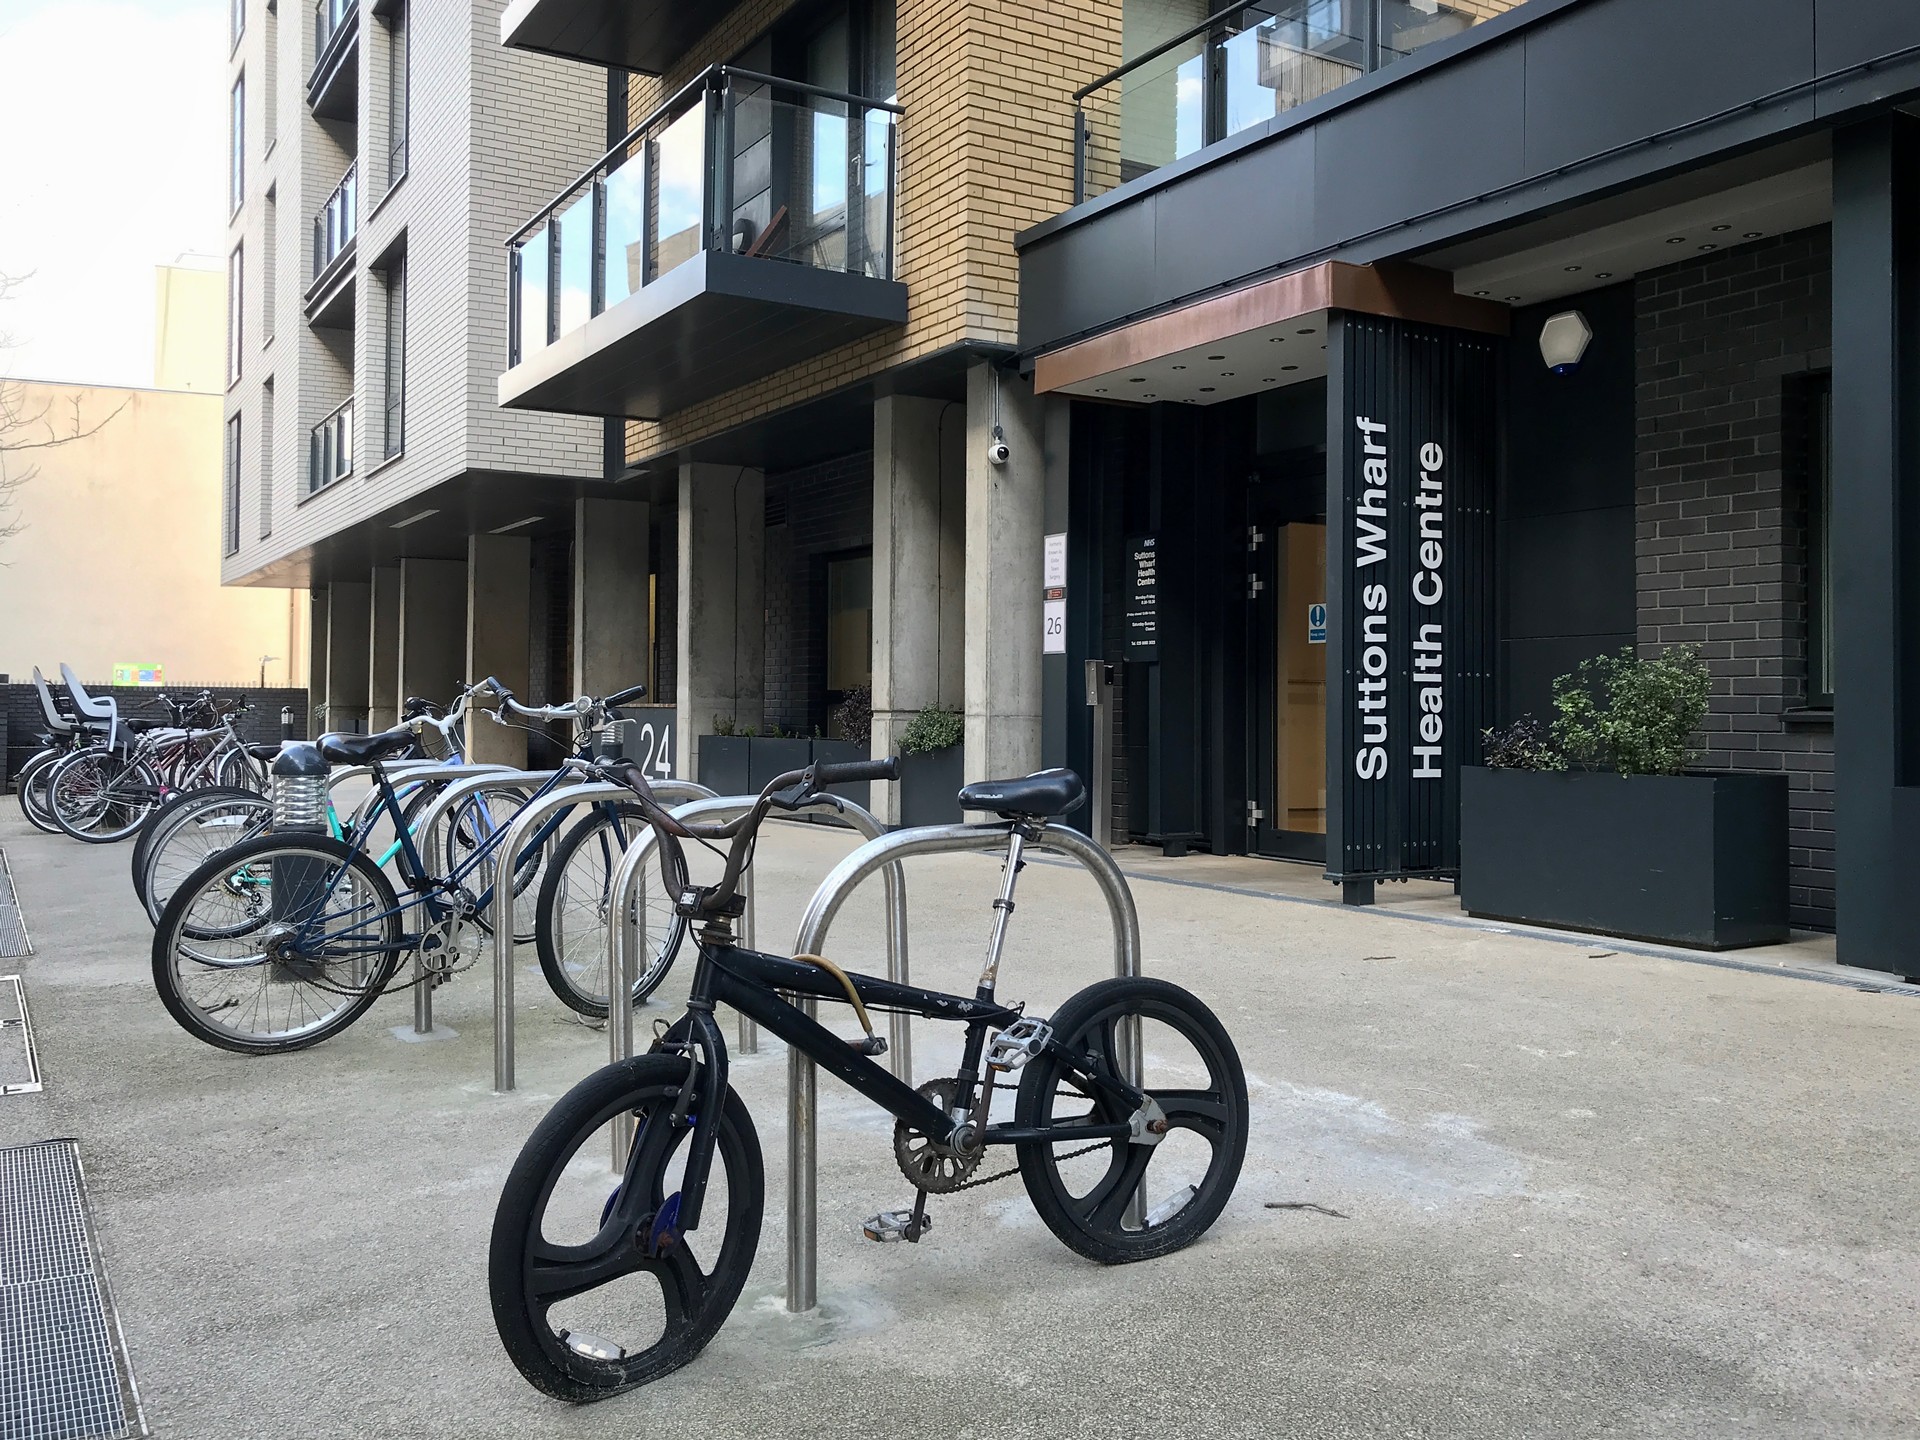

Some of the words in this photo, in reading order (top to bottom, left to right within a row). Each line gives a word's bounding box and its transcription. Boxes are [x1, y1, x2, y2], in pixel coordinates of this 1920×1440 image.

[1356, 416, 1388, 567] Wharf
[1412, 442, 1444, 606] Centre
[1144, 538, 1155, 547] NHS
[1134, 551, 1155, 560] Suttons
[1139, 558, 1155, 568] Wharf
[1137, 577, 1155, 586] Centre
[1138, 567, 1155, 577] Health
[1047, 616, 1062, 635] 26
[1356, 585, 1388, 780] Suttons
[1412, 624, 1443, 778] Health
[640, 722, 671, 780] 24
